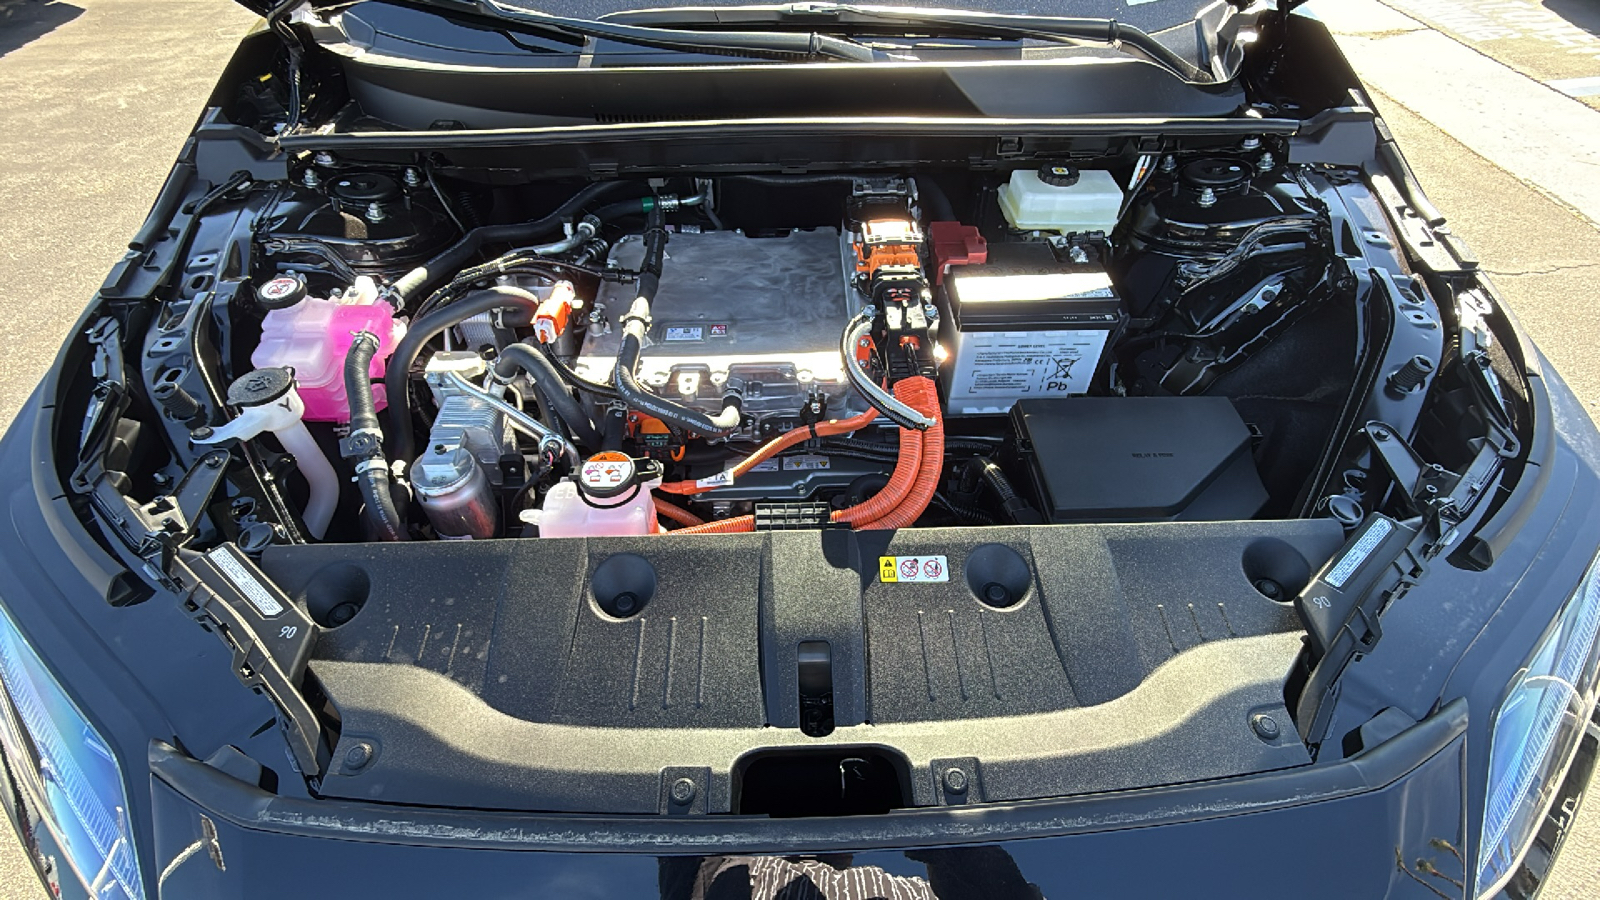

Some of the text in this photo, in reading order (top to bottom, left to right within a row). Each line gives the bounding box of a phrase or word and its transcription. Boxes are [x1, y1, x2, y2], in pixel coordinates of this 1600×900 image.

[1046, 381, 1067, 391] Pb
[1312, 596, 1332, 609] 90
[278, 626, 298, 639] 90
